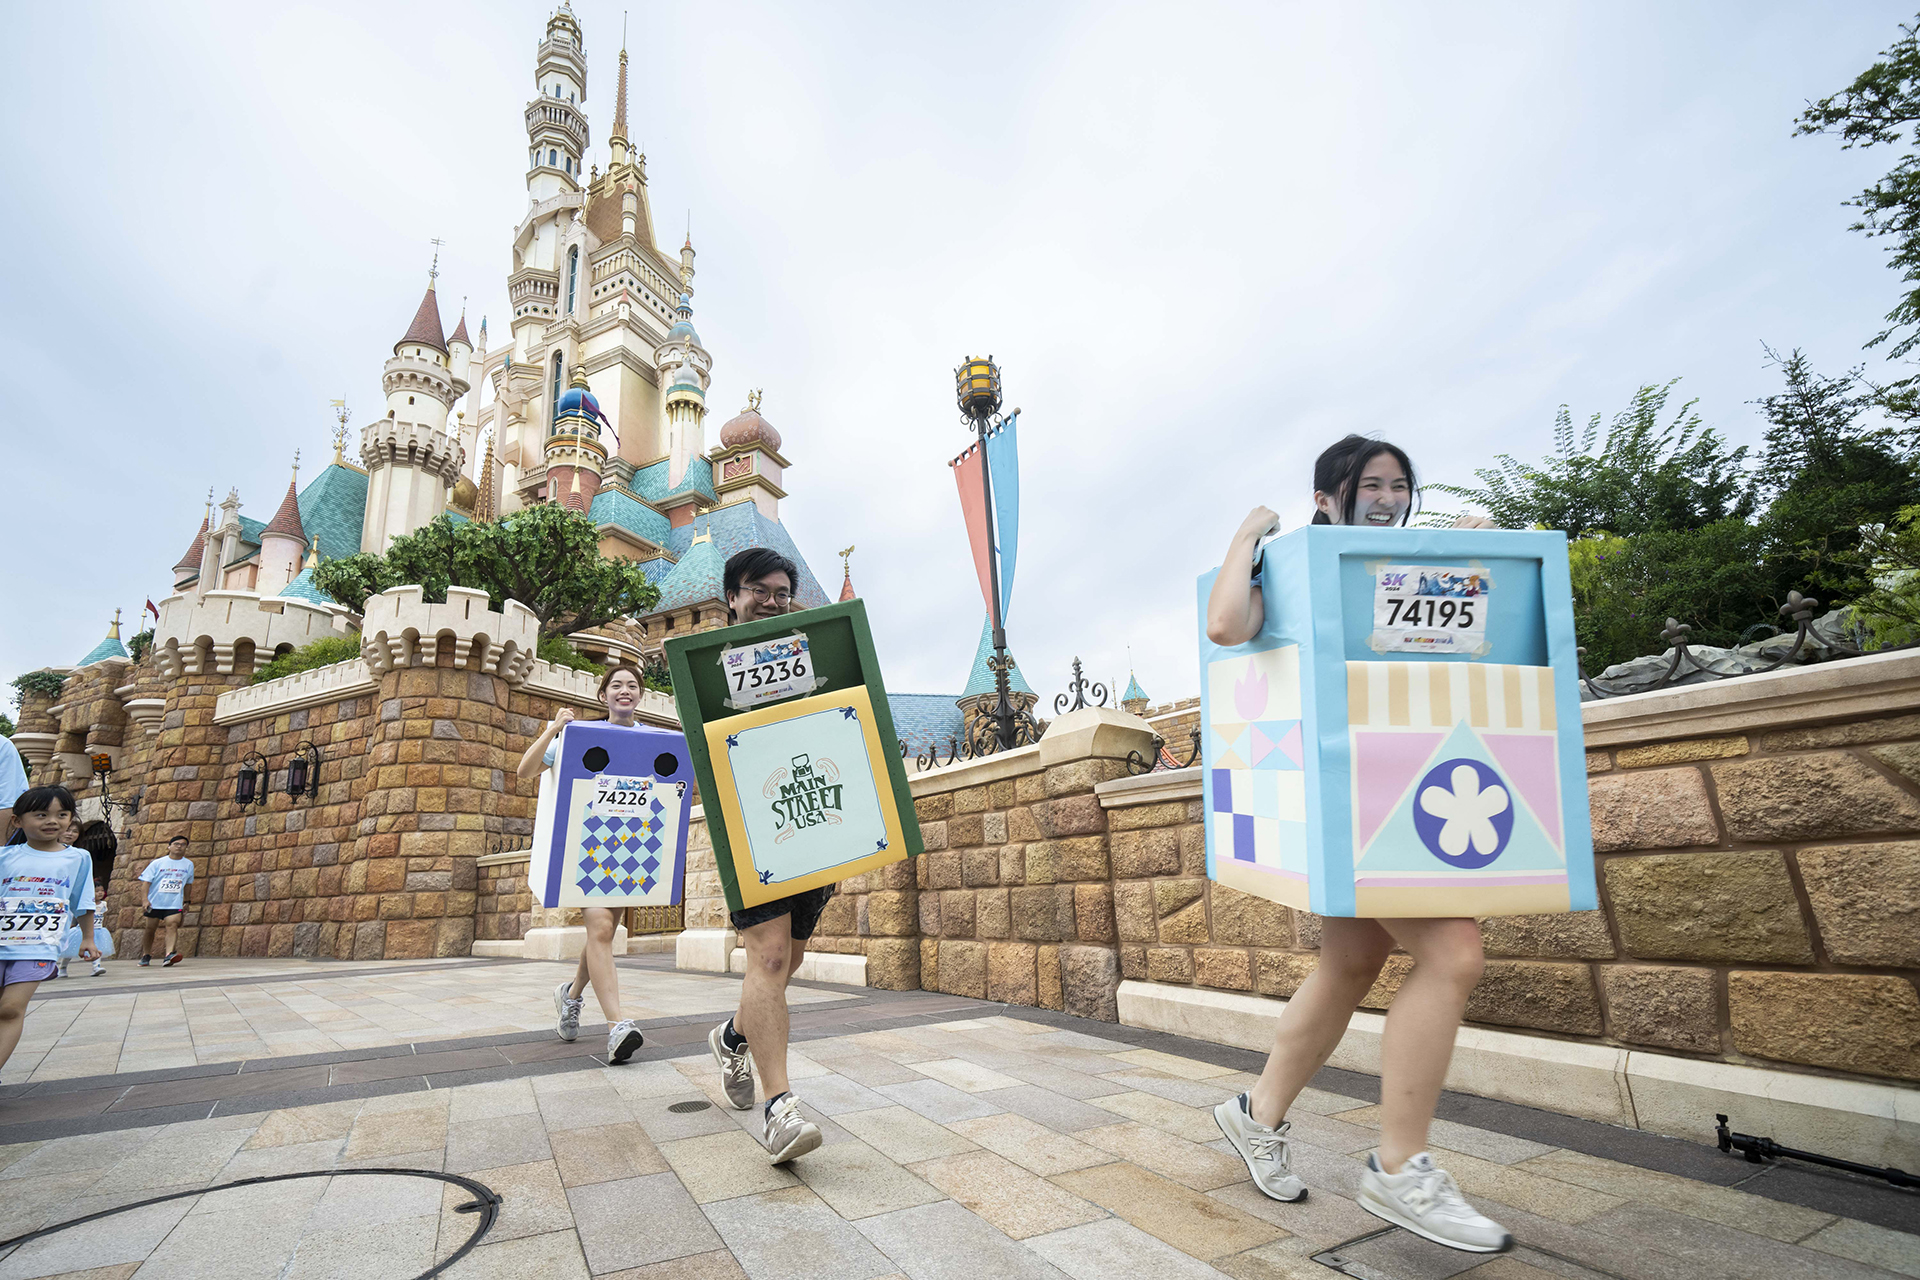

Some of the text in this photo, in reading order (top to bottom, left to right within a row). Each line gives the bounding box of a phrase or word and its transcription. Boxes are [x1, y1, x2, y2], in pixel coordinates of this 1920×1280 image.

[1381, 573, 1408, 586] 3K
[1386, 599, 1474, 628] 74195
[727, 652, 744, 665] 3K
[732, 657, 806, 691] 73236
[779, 775, 827, 799] MAIN
[598, 791, 647, 806] 74226
[771, 784, 843, 830] STREET
[794, 811, 827, 829] USA
[0, 915, 61, 931] 3793
